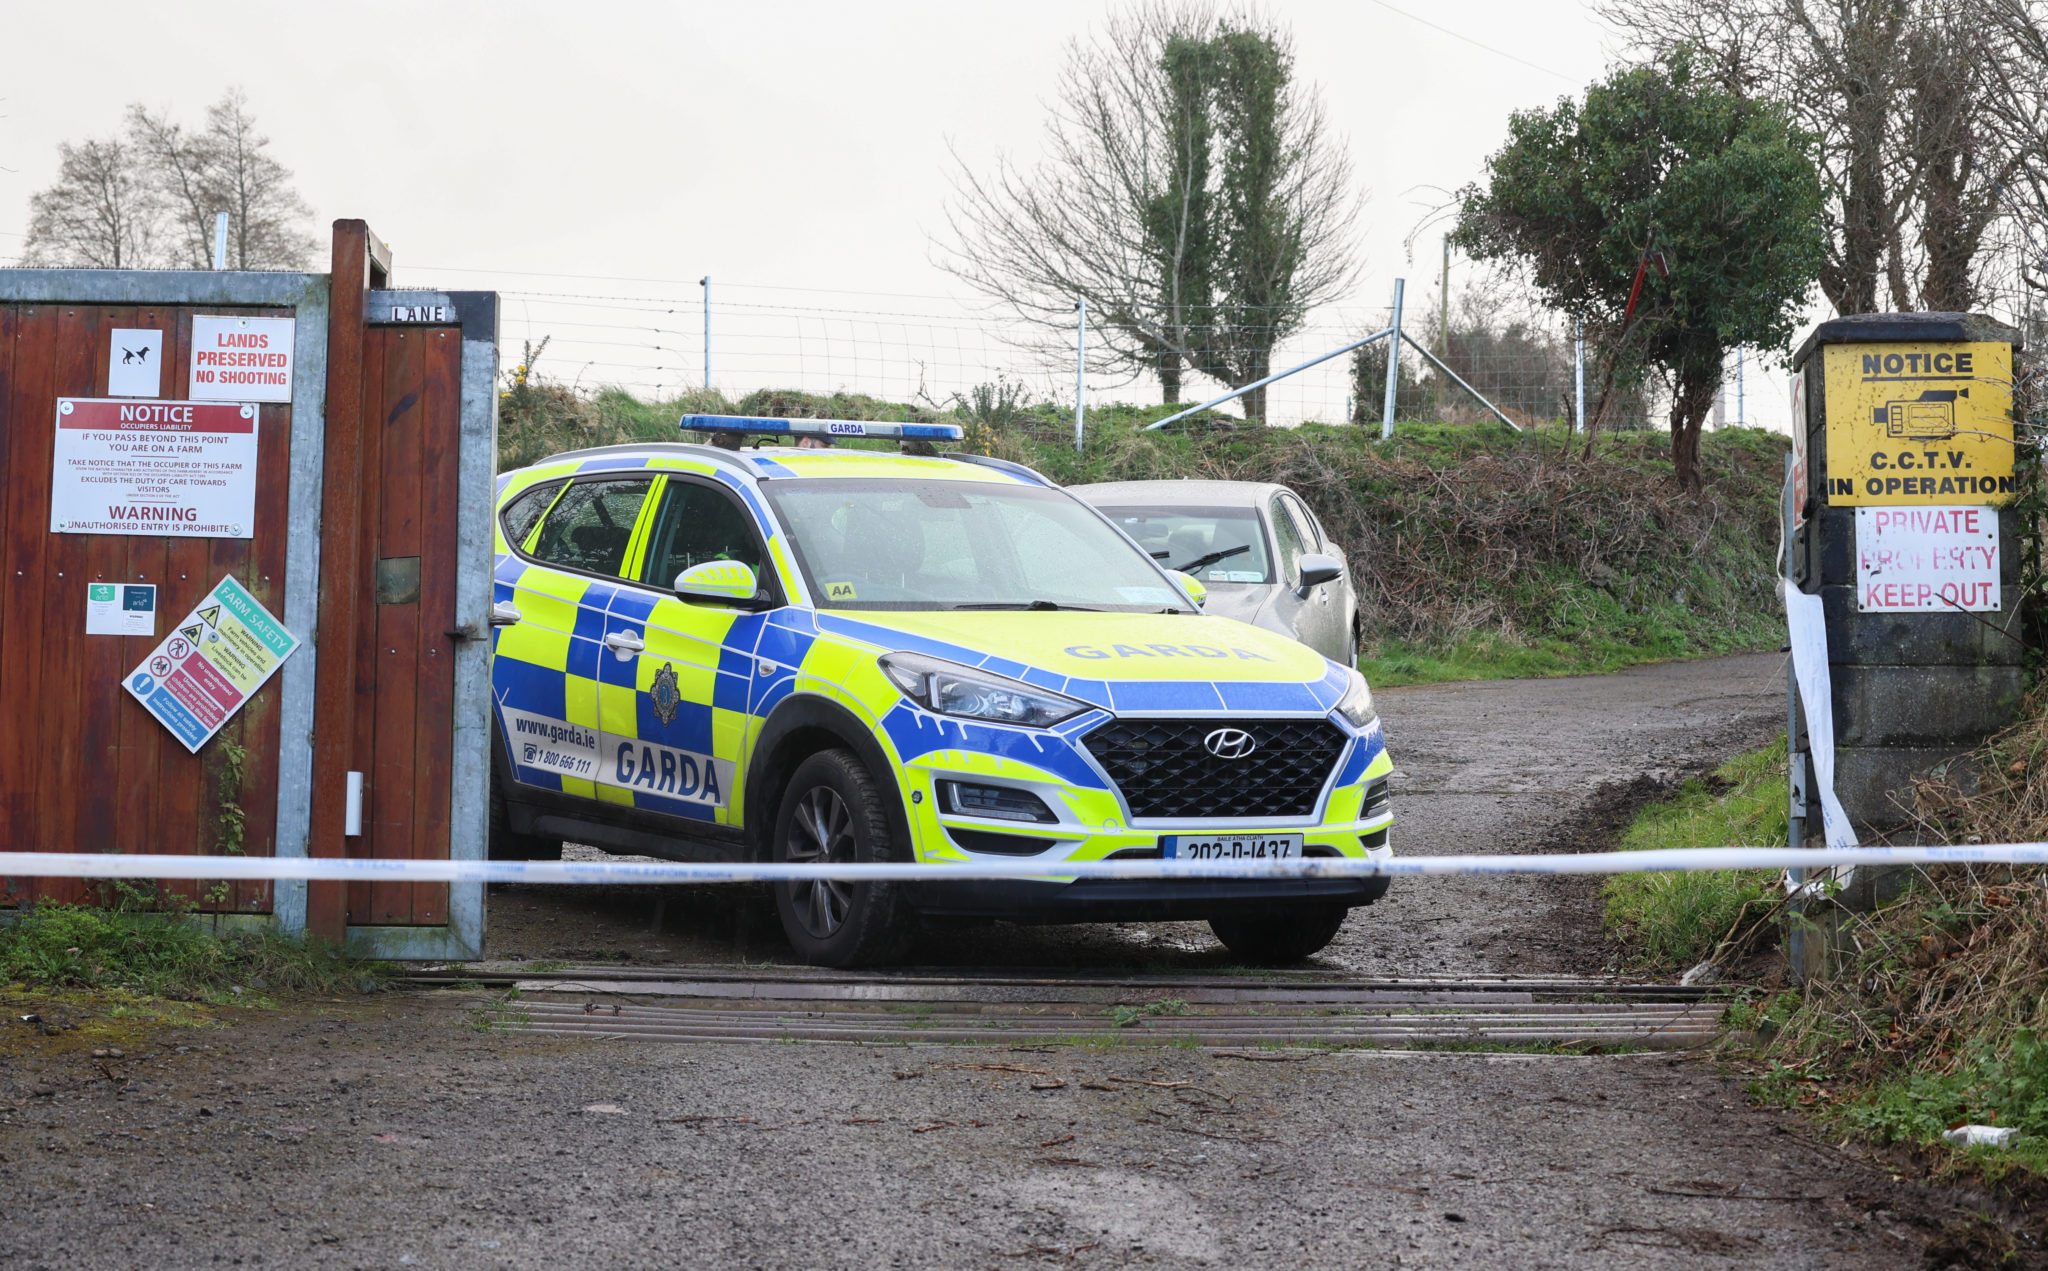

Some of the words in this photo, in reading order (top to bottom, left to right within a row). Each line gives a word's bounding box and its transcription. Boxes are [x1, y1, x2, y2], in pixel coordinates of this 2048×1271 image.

[394, 306, 442, 321] LANE
[218, 333, 268, 348] LANDS
[197, 352, 287, 368] PRESERVED
[1862, 353, 1973, 374] NOTICE
[196, 370, 214, 383] NO
[219, 371, 286, 385] SHOOTING
[120, 406, 194, 422] NOTICE
[92, 433, 112, 441] YOU
[115, 434, 136, 442] PASS
[140, 434, 177, 442] BEYOND
[202, 436, 230, 444] POINT
[830, 423, 864, 434] GARDA
[109, 444, 128, 452] YOU
[131, 444, 148, 452] ARE
[153, 461, 189, 469] OCCUPIER
[1870, 451, 1972, 470] C.C.T.V.
[80, 476, 118, 484] EXCLUDES
[169, 478, 187, 486] CARE
[1828, 478, 1853, 496] IN
[1866, 476, 2015, 496] OPERATION
[109, 506, 197, 522] WARNING
[1876, 510, 1980, 534] PRIVATE
[68, 521, 138, 530] UNAUTHORISED
[141, 522, 169, 531] ENTRY
[183, 524, 230, 532] PROHIBITE
[832, 585, 852, 596] AA
[1866, 583, 1932, 607] KEEP
[1941, 582, 1992, 607] OUT
[220, 586, 251, 616] FARM
[249, 614, 288, 650] SAFETY
[227, 626, 240, 639] Farm
[240, 639, 257, 656] vehicles
[256, 655, 266, 664] and
[240, 628, 263, 652] WARNING
[211, 646, 232, 667] Livestock
[218, 628, 240, 650] machinery
[245, 653, 266, 674] operation
[223, 647, 246, 669] WARNING
[1064, 644, 1276, 662] GARDA
[196, 661, 204, 670] No
[204, 667, 233, 696] unauthorised
[213, 657, 236, 680] dangerous
[183, 677, 218, 711] Unaccompanied
[203, 678, 216, 691] entry
[163, 698, 177, 712] Follow
[166, 681, 178, 693] from
[177, 692, 195, 710] entering
[202, 716, 214, 728] farm
[171, 676, 189, 695] children
[196, 700, 219, 723] prohibited
[516, 718, 595, 749] www.garda.ie
[538, 750, 543, 762] 1
[543, 750, 560, 766] 800
[560, 754, 574, 769] 666
[576, 758, 591, 774] 111
[616, 742, 721, 804] GARDA
